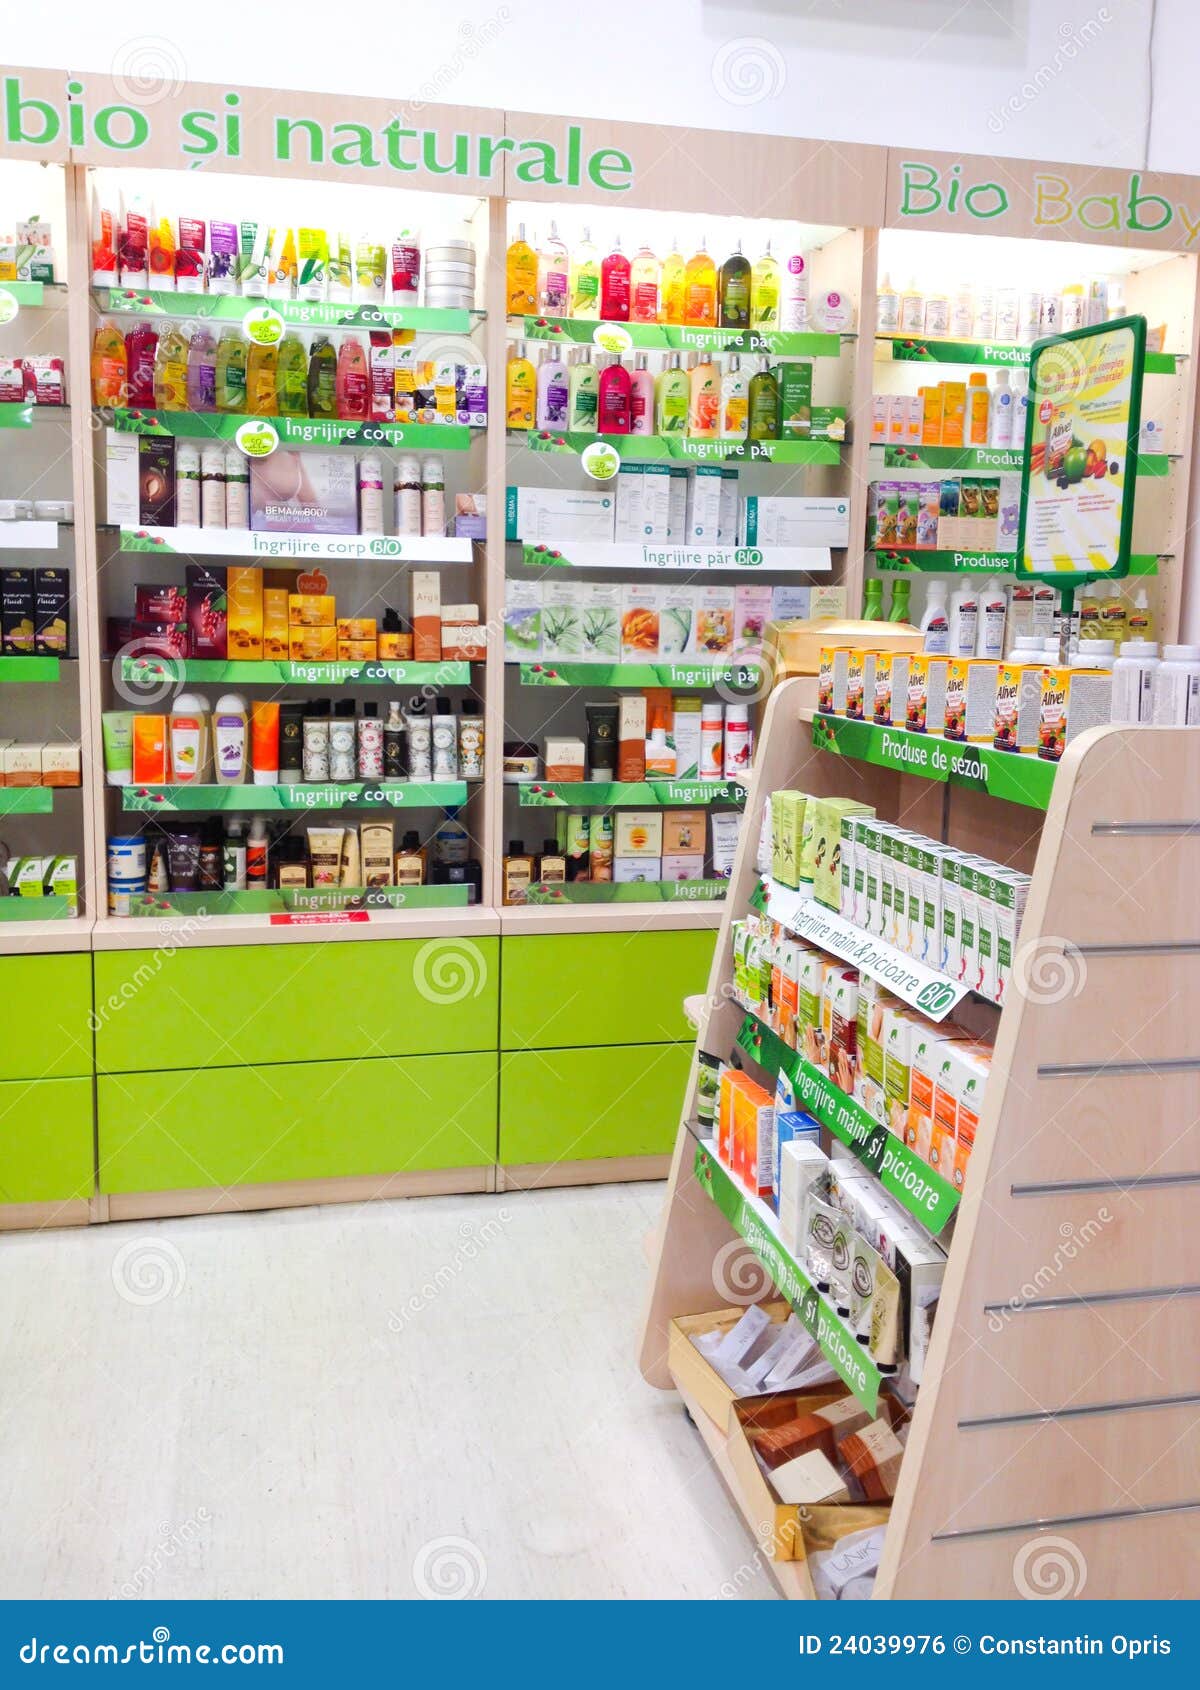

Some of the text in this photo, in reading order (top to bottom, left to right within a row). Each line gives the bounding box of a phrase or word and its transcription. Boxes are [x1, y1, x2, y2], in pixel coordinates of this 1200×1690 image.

[4, 77, 634, 191] bio și naturale
[901, 163, 1009, 218] Bio
[361, 309, 404, 325] corp
[984, 346, 1031, 362] Produs
[286, 419, 404, 444] Îngrijire corp
[976, 451, 1024, 465] Produs
[253, 534, 401, 557] Îngrijire corp BIO
[642, 546, 763, 567] Îngrijire păr BIO
[954, 554, 1009, 567] Produse
[290, 660, 407, 683] Îngrijire corp
[671, 665, 732, 684] Îngrijire
[946, 679, 965, 693] Alive!
[997, 684, 1018, 700] Alive!
[1042, 689, 1065, 706] Alive!
[881, 733, 988, 782] Produse de sezon
[289, 784, 404, 806] Îngrijire corp
[669, 782, 729, 802] Îngrijire
[294, 888, 406, 909] Îngrijire corp
[675, 882, 728, 899] Îngrijir
[916, 981, 957, 1015] BIO
[794, 1060, 940, 1211] Îngrijire mâini și picioare
[817, 1317, 867, 1392] picioare
